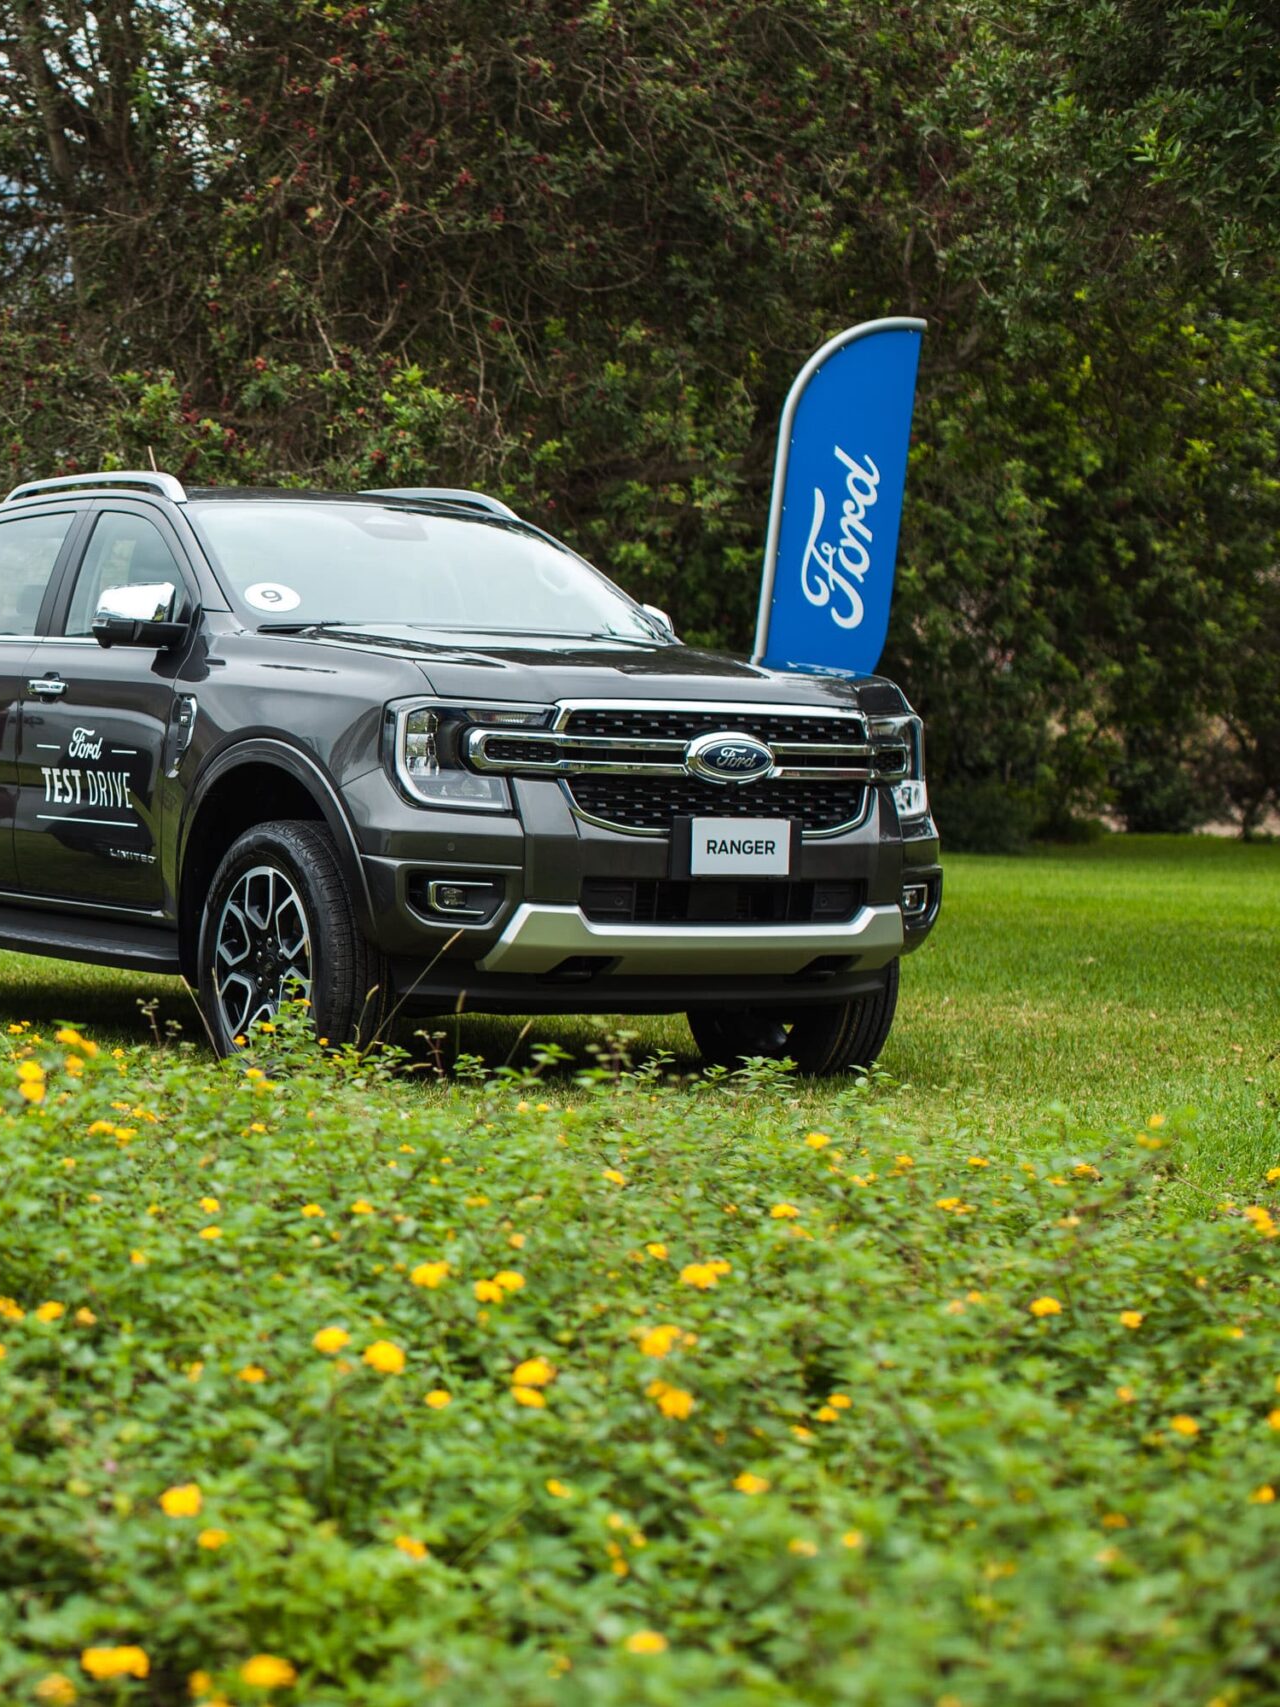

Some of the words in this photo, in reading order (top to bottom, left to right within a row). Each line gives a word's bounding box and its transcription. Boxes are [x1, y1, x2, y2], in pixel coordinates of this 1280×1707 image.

[801, 444, 880, 629] Ford
[260, 590, 282, 603] 9
[68, 727, 103, 760] Ford
[716, 746, 757, 768] Ford
[41, 767, 81, 805] TEST
[86, 770, 133, 808] DRIVE
[706, 839, 776, 855] RANGER
